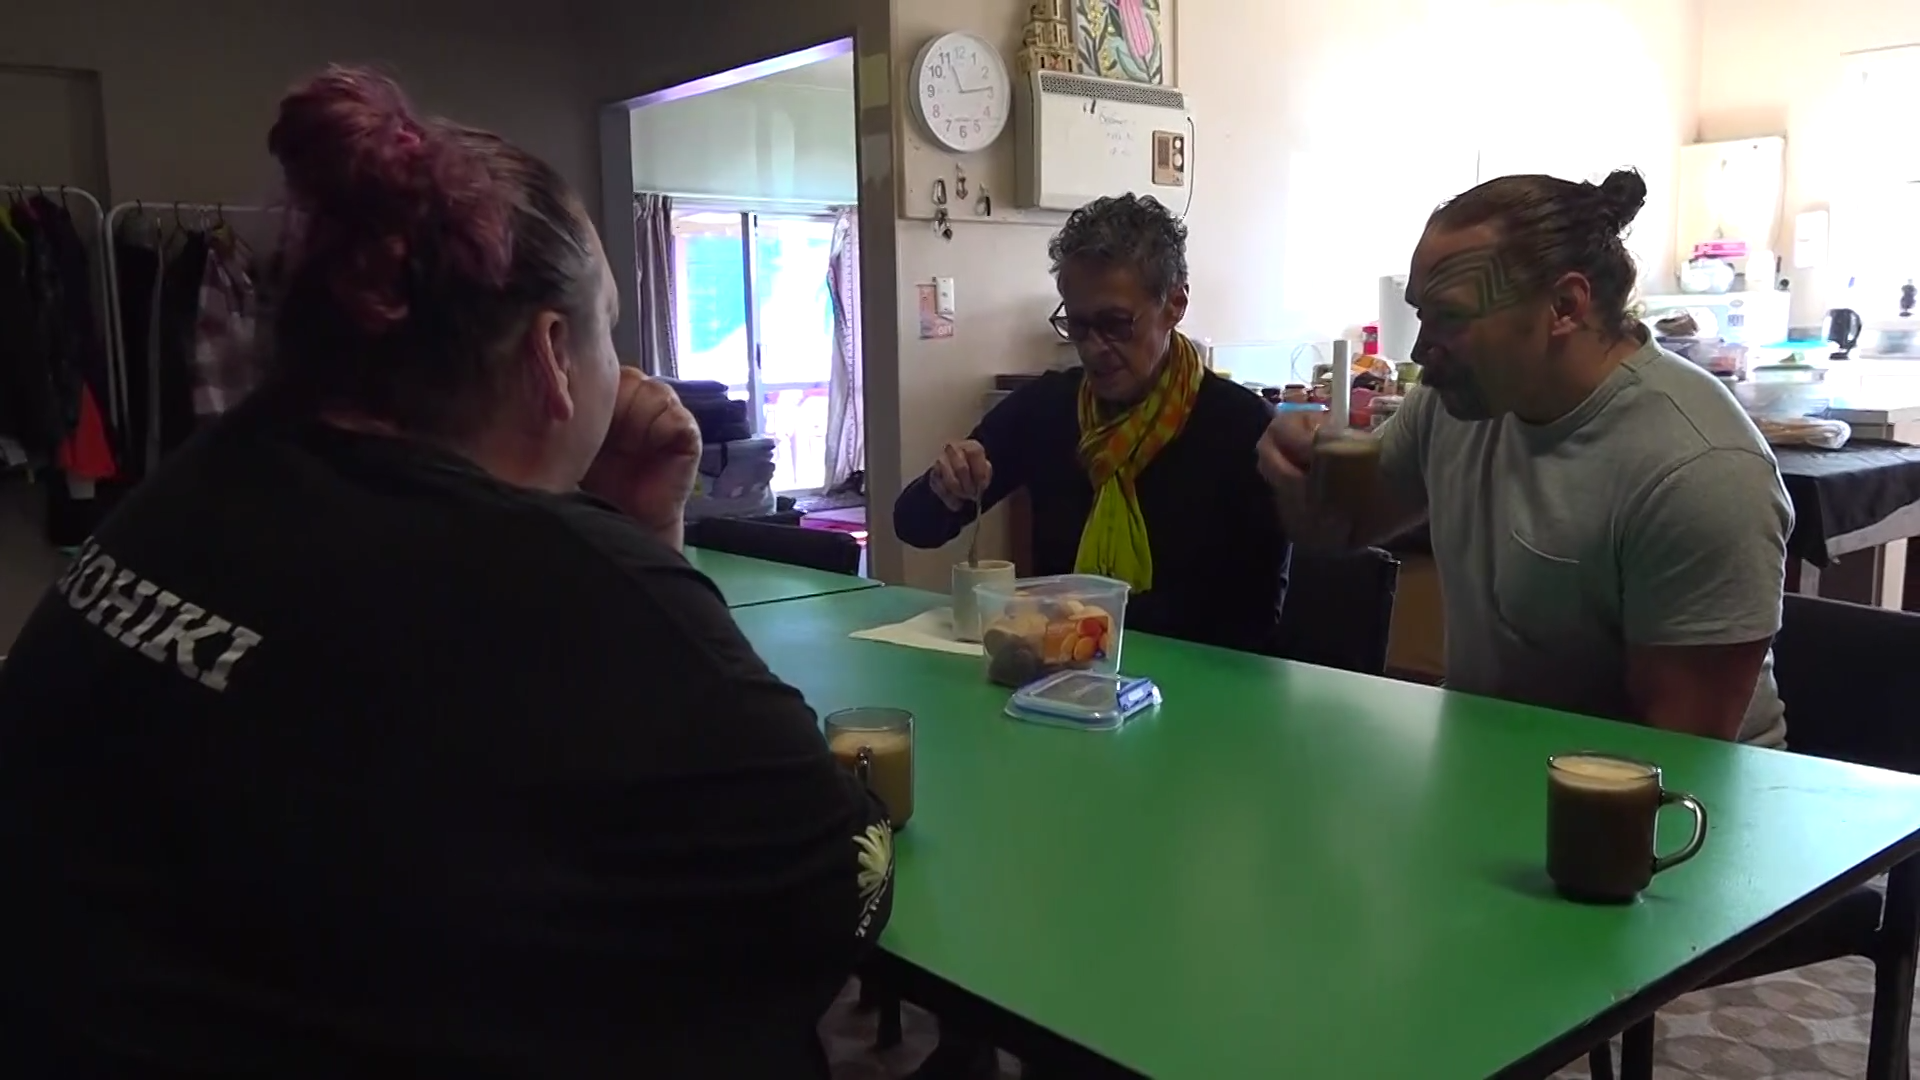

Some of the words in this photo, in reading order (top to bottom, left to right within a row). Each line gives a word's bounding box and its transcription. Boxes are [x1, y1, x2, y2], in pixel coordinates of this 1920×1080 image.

[939, 52, 951, 66] 11
[954, 46, 966, 60] 12
[971, 52, 977, 65] 1
[929, 65, 943, 79] 10
[981, 66, 989, 80] 2
[927, 84, 935, 98] 9
[932, 104, 941, 118] 8
[983, 105, 991, 118] 4
[944, 119, 952, 132] 7
[959, 125, 968, 139] 6
[973, 119, 981, 134] 5
